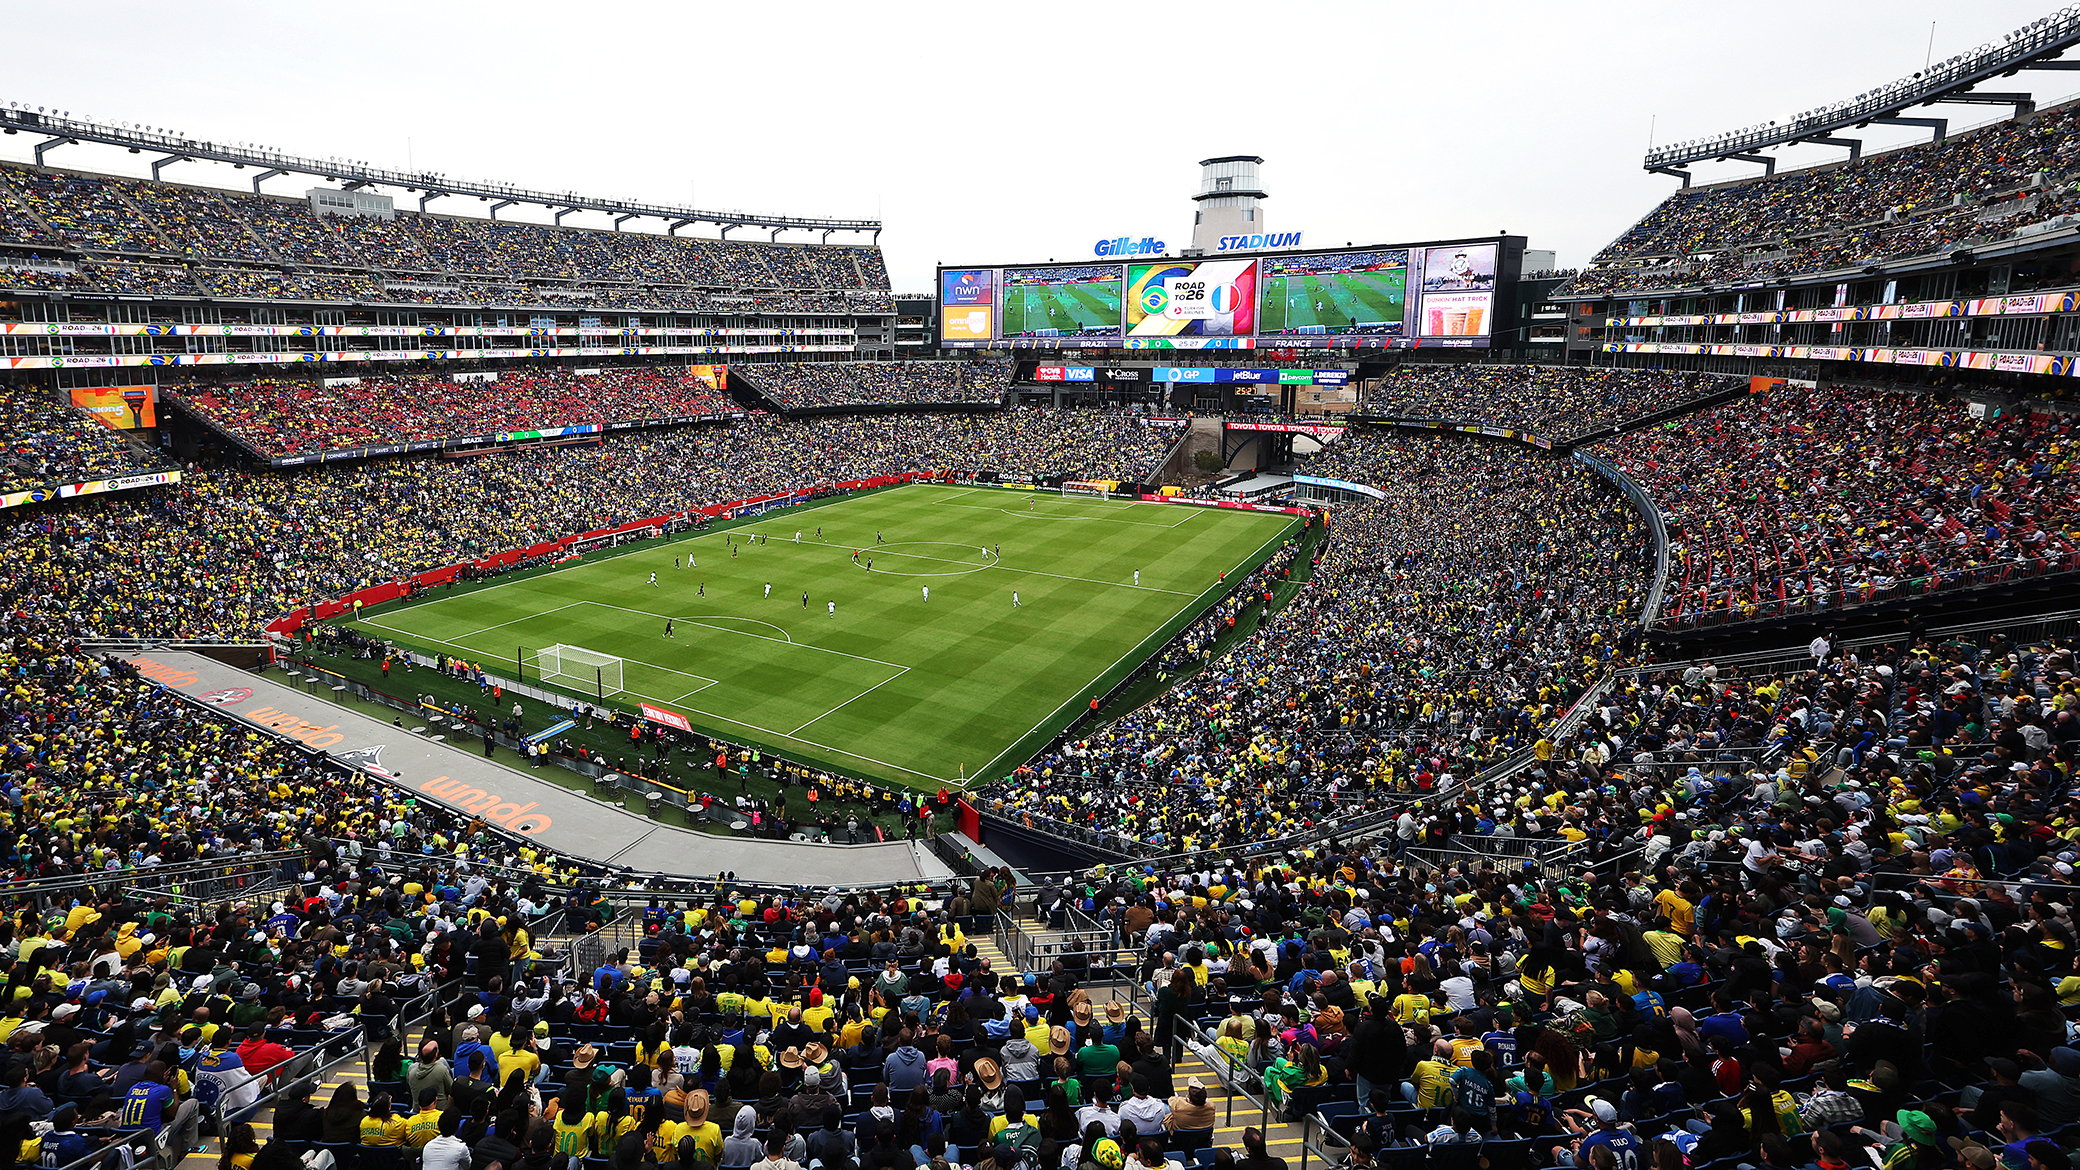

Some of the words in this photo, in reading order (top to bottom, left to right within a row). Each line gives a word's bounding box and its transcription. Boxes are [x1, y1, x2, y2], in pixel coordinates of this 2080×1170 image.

[1094, 237, 1166, 257] Gillette
[1217, 232, 1301, 250] STADIUM
[955, 286, 980, 295] nwn
[1174, 281, 1205, 290] ROAD
[1185, 290, 1205, 300] 26
[1066, 368, 1094, 380] VISA
[1232, 371, 1262, 381] jetBlue
[1288, 373, 1312, 381] paycom
[611, 422, 632, 430] FRANCE
[1230, 422, 1256, 430] TOYOTA
[1258, 423, 1285, 431] TOYOTA
[1286, 425, 1314, 433] TOYOTA
[1316, 426, 1344, 434] TOYOTA
[461, 437, 483, 445] BRAZIL
[393, 445, 400, 453] 0
[120, 477, 141, 485] ROAD
[1464, 1079, 1488, 1095] HASSAN
[123, 1098, 148, 1126] 10
[1525, 1111, 1541, 1126] 10
[362, 1127, 386, 1137] BRASIL
[411, 1121, 437, 1134] BRASIL
[1381, 1130, 1395, 1145] 30
[560, 1131, 578, 1155] 10
